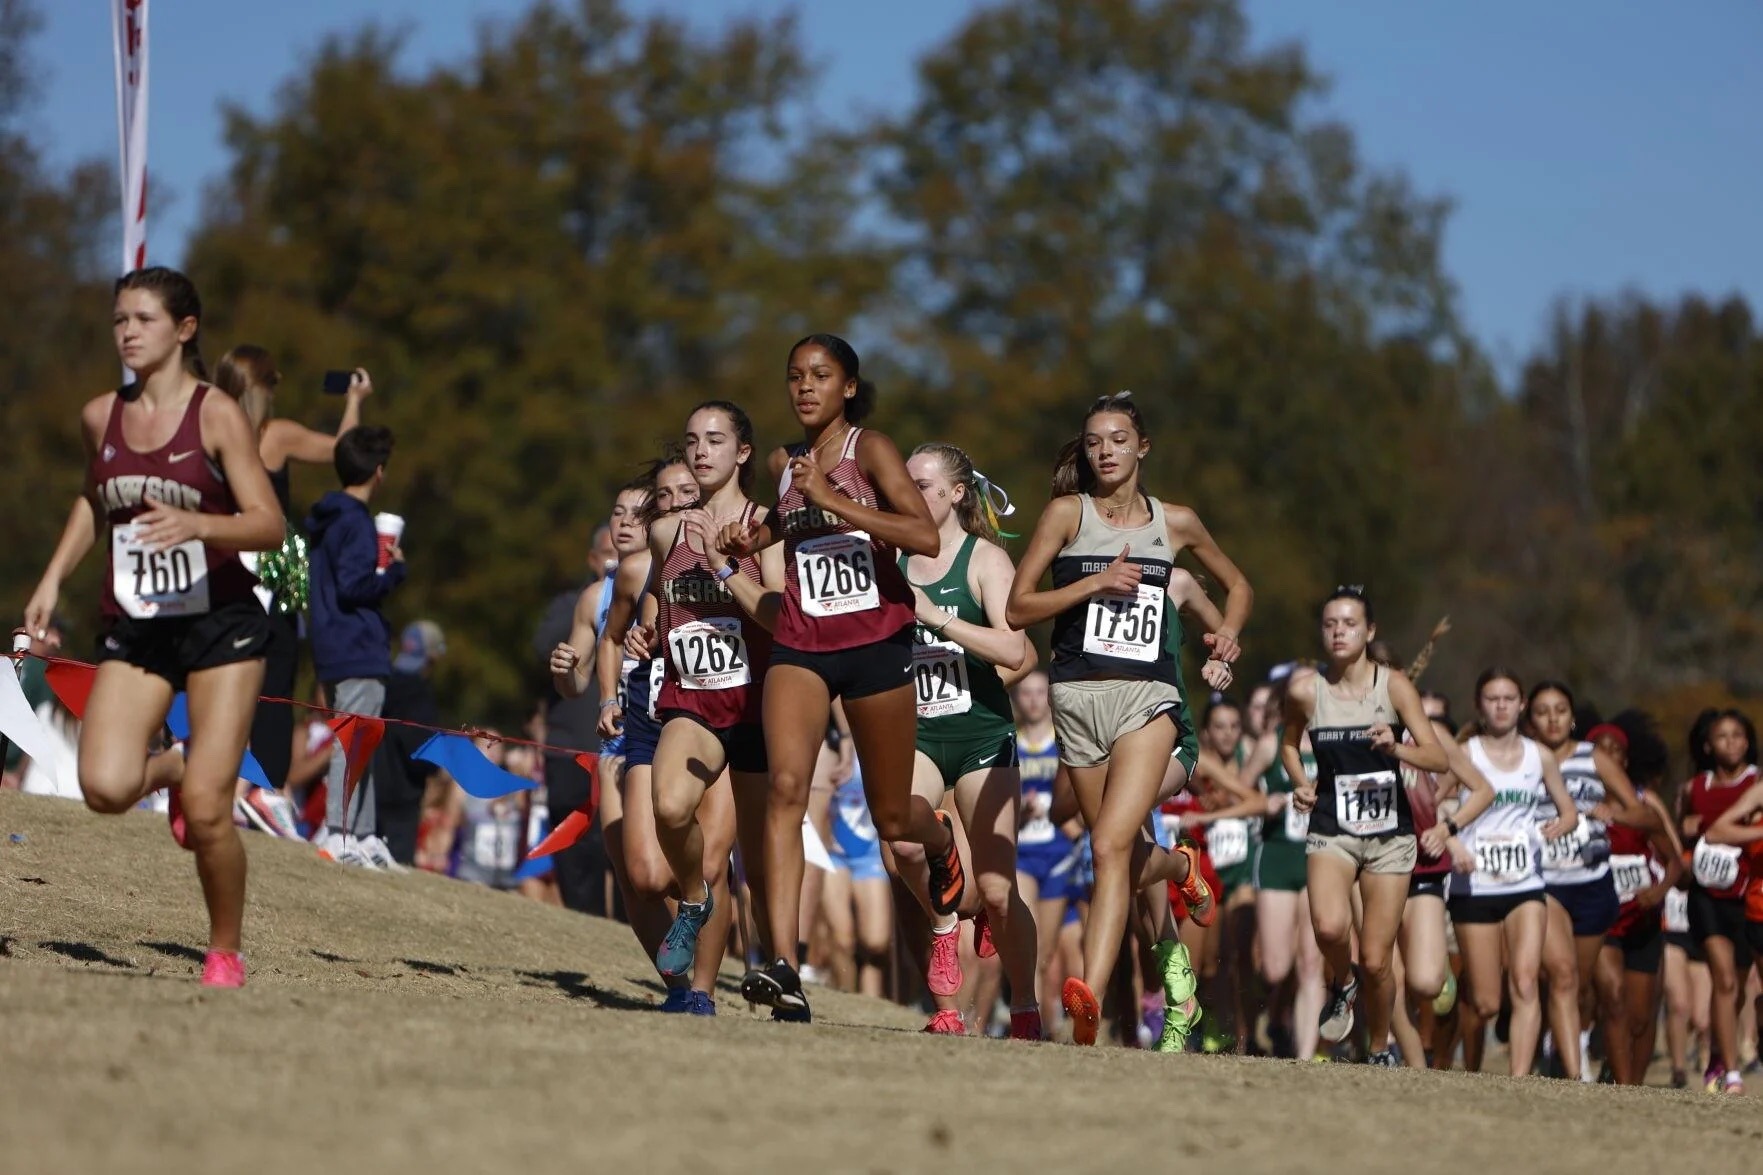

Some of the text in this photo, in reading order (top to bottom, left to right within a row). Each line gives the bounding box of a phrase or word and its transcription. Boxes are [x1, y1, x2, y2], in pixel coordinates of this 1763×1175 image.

[127, 545, 192, 595] 760
[803, 551, 871, 599] 1266
[1082, 562, 1112, 573] MAR
[663, 578, 734, 604] HEBRO
[1091, 598, 1157, 645] 1756
[675, 633, 744, 675] 1262
[1115, 645, 1141, 654] ATLANTA
[708, 676, 732, 685] ATLANTA
[916, 660, 963, 702] 021
[930, 703, 954, 712] ATLANTA
[1318, 731, 1345, 741] MARY
[1343, 787, 1394, 821] 1757
[1478, 843, 1527, 873] 1070
